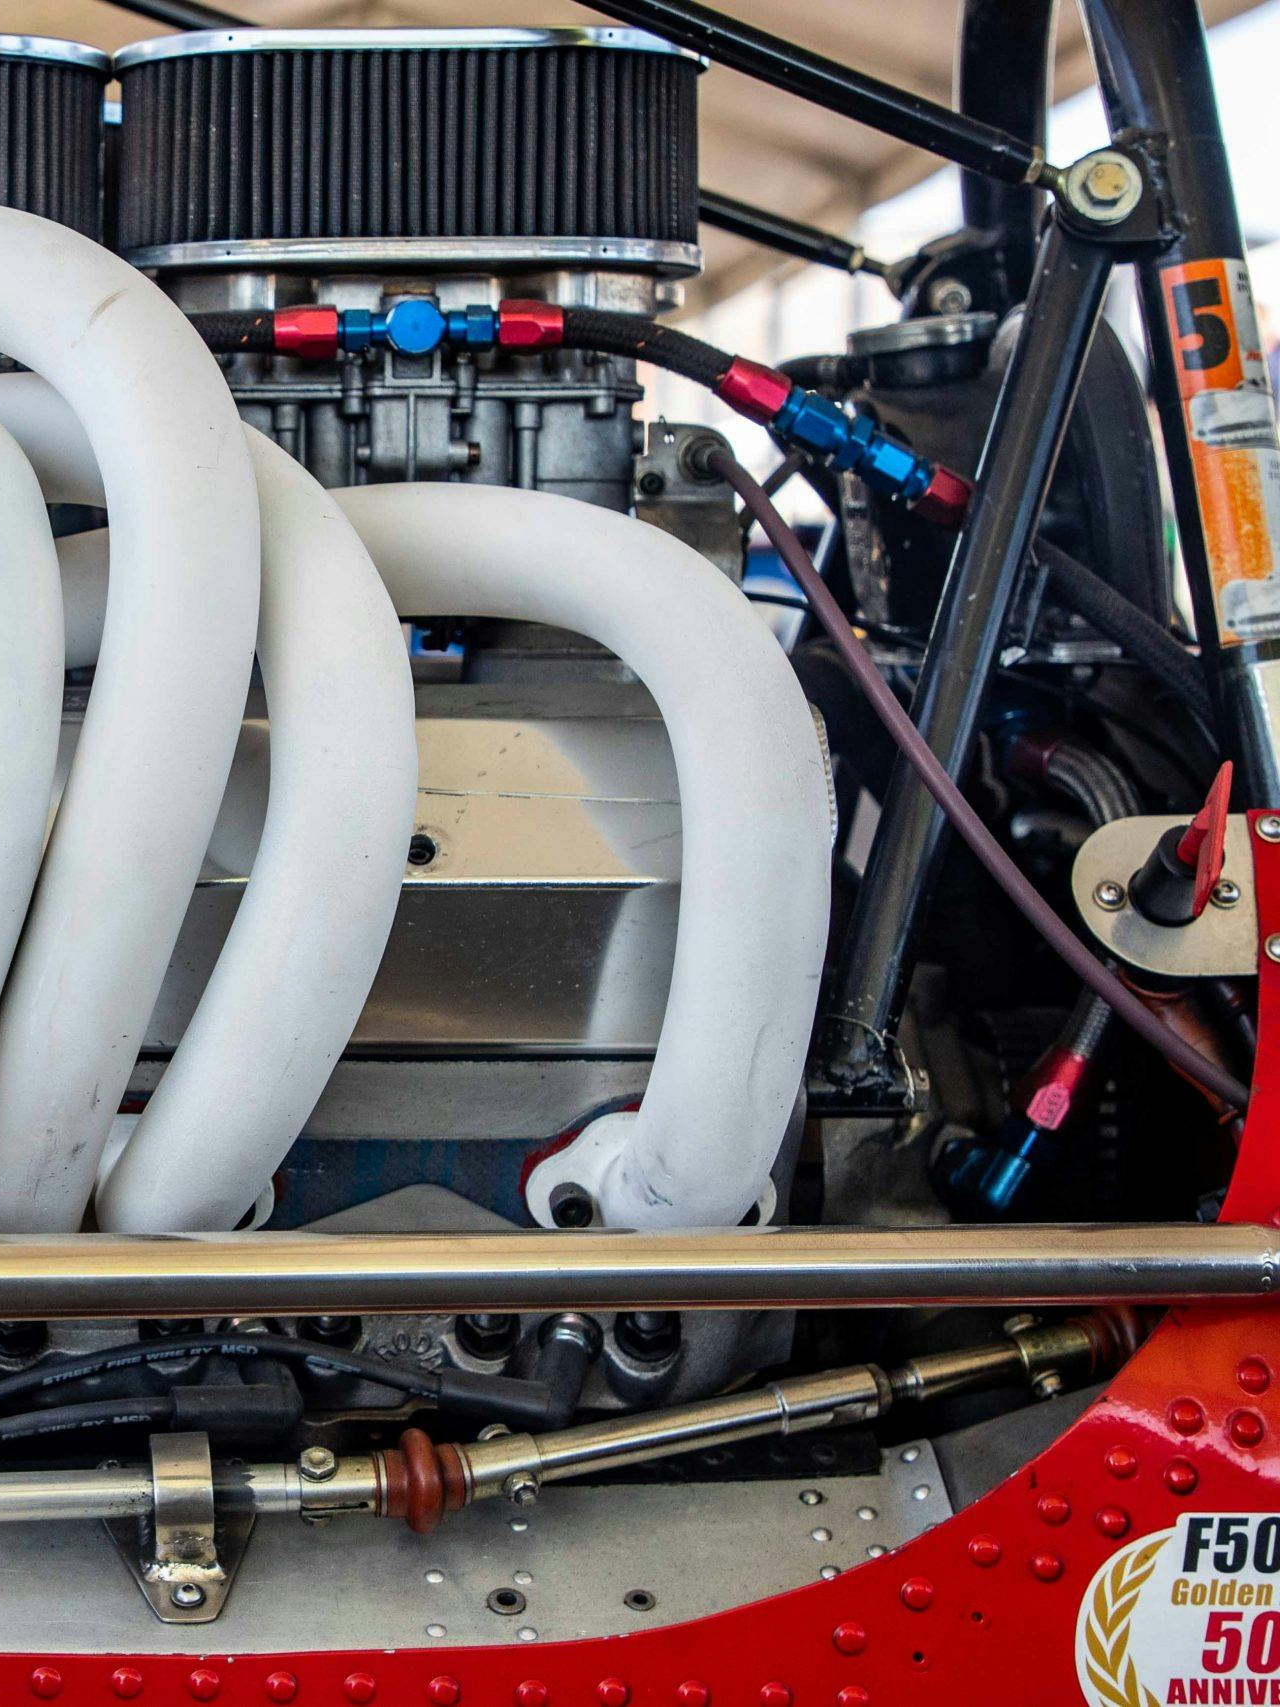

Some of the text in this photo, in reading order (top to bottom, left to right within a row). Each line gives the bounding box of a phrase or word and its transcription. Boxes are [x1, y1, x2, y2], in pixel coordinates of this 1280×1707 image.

[1171, 278, 1231, 371] 5
[42, 1344, 259, 1386] STREET FIRE WIRE BY MSD
[1182, 1516, 1280, 1574] F50
[1171, 1577, 1274, 1606] Golden
[1202, 1610, 1280, 1674] 50
